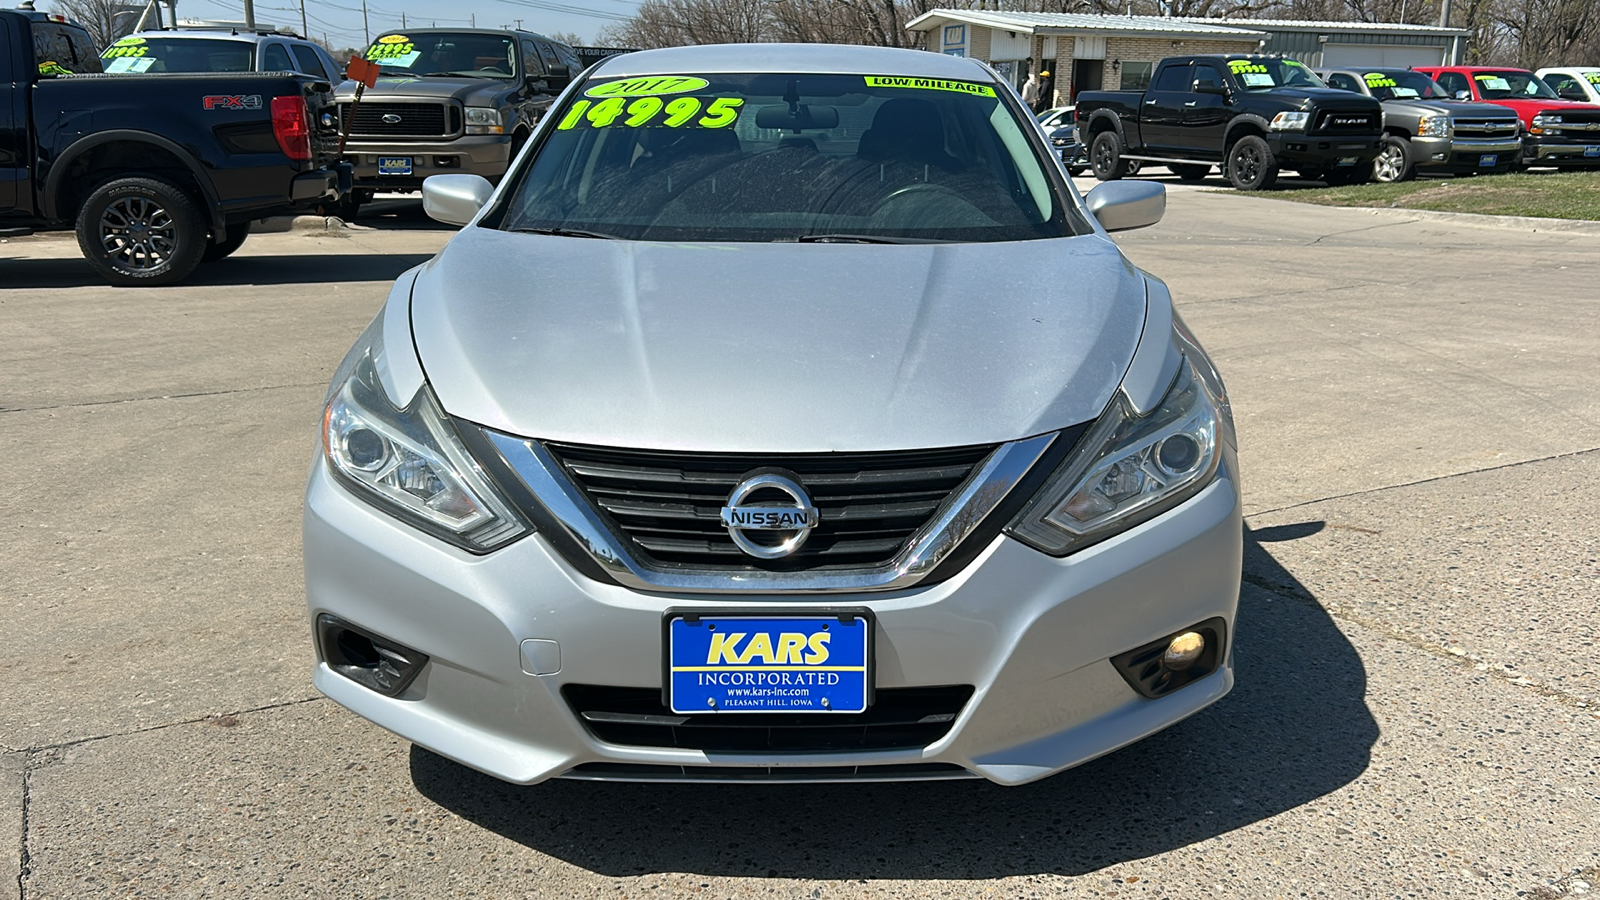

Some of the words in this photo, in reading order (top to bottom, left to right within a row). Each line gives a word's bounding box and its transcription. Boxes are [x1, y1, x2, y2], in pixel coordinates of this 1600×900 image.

[102, 46, 149, 59] 11995
[367, 43, 414, 56] 12995
[602, 78, 691, 95] 2017
[873, 77, 910, 86] LOW
[914, 79, 986, 94] MILEAGE
[203, 95, 262, 109] FX4
[557, 97, 745, 131] 14995
[731, 512, 808, 525] NISSAN
[706, 632, 831, 665] KARS
[698, 672, 840, 686] INCORPORATED
